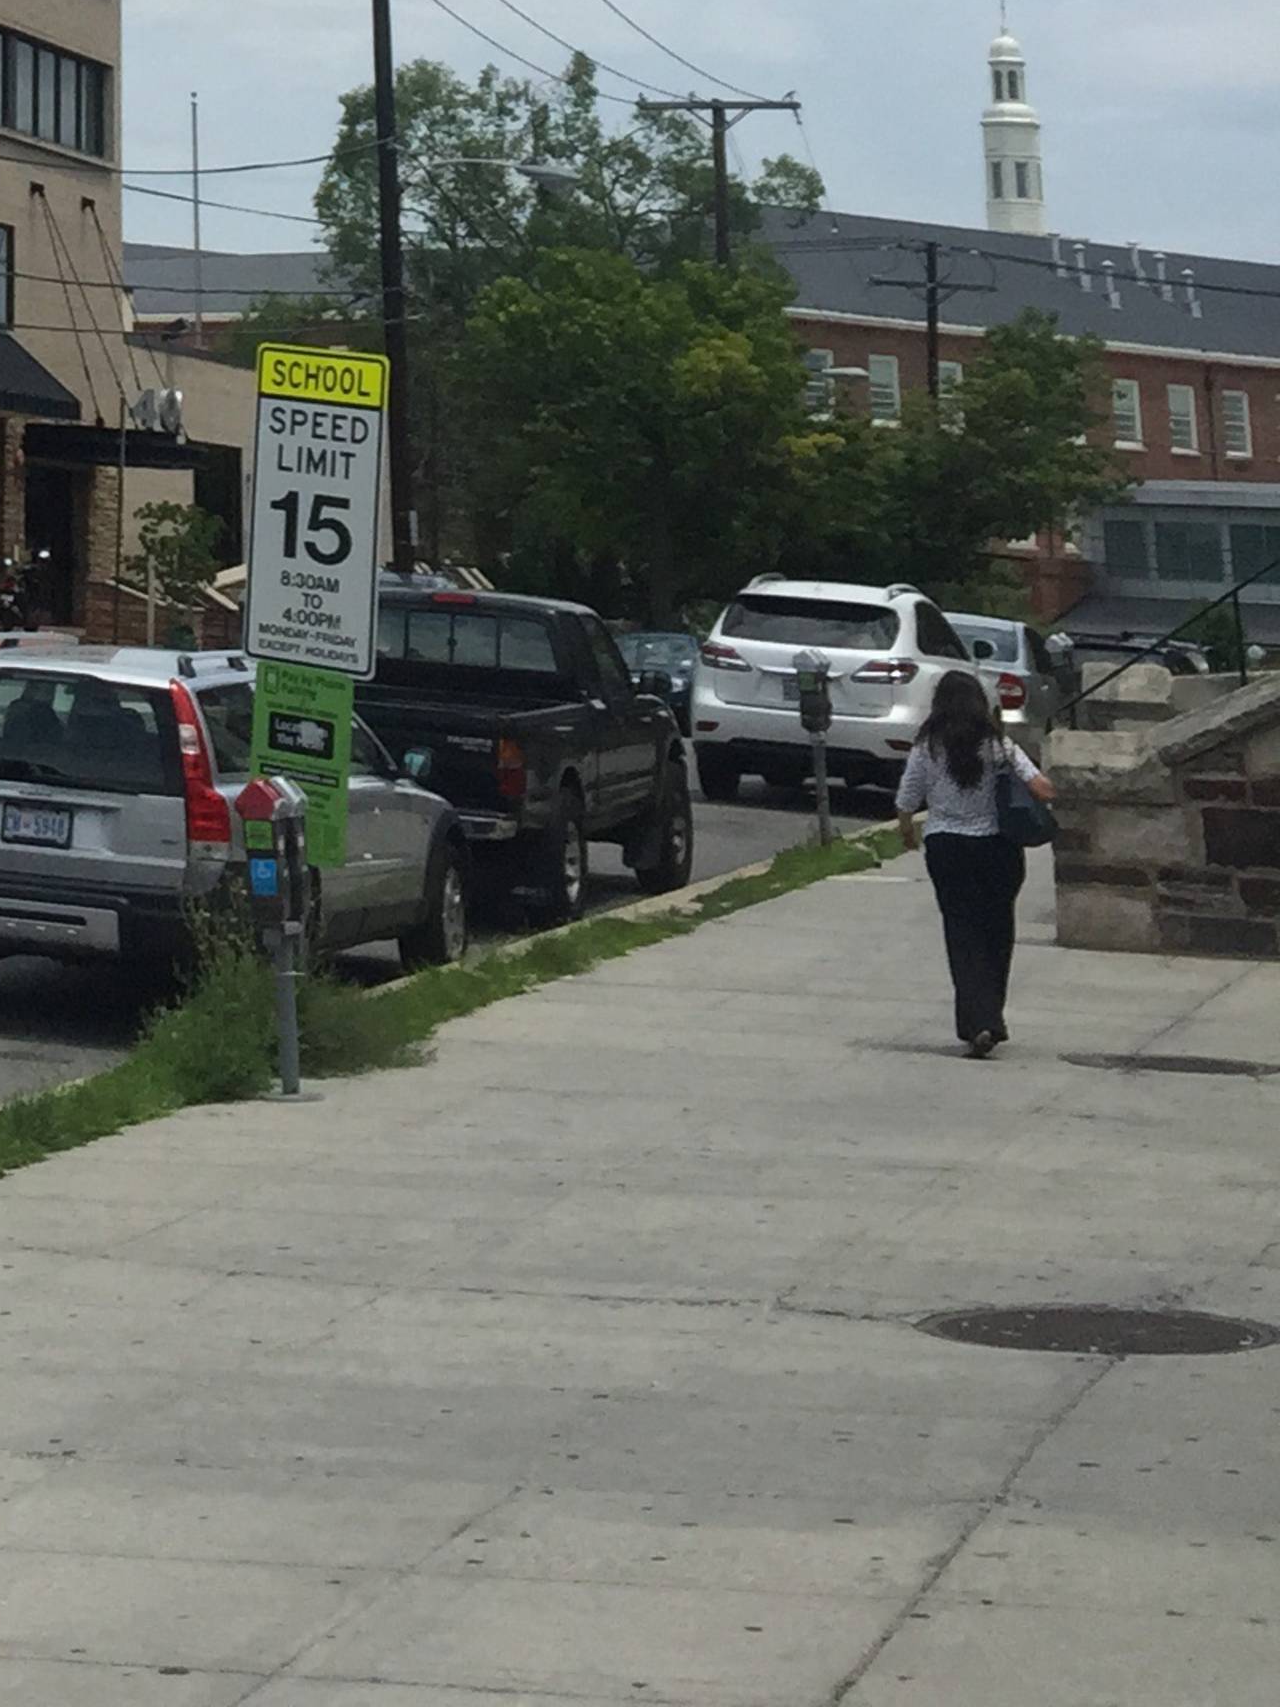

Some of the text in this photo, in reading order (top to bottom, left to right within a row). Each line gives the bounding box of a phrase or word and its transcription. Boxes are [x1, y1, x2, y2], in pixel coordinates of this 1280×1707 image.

[272, 359, 371, 397] SCHOOL
[269, 406, 369, 444] SPEED
[277, 443, 356, 479] LIMIT
[270, 490, 352, 566] 15
[280, 570, 339, 593] 8:30AM
[282, 607, 341, 629] 4:00PM
[302, 593, 323, 609] TO
